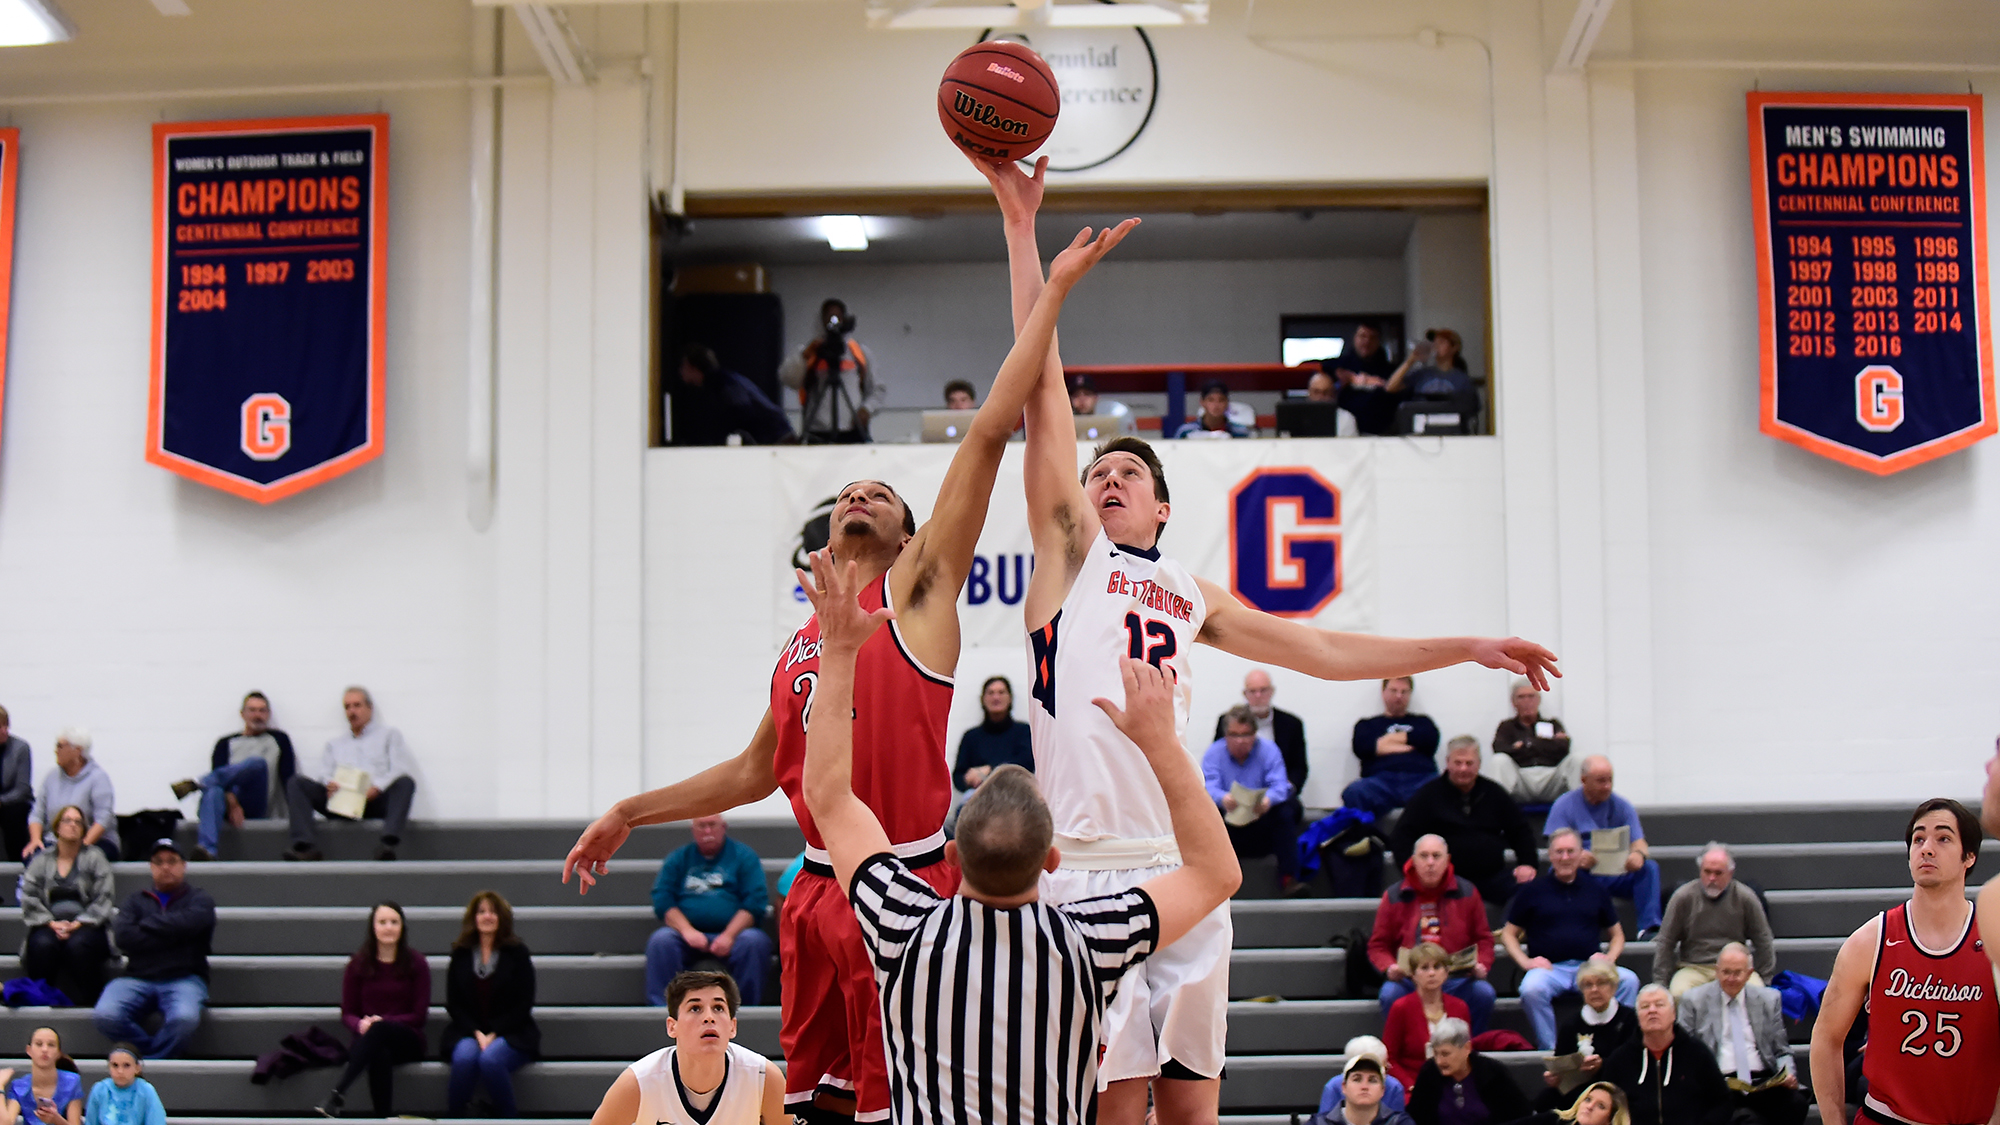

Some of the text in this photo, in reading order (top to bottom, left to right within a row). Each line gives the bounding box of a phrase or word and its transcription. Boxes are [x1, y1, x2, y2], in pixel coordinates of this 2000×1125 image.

[986, 62, 1025, 83] Bullets
[954, 88, 1029, 136] Wilson
[954, 132, 1010, 158] NCAA
[1785, 125, 1946, 148] MEN'S SWIMMING
[175, 150, 364, 172] WOMEN'S OUTDOOR TRACK & FIELD
[1777, 152, 1960, 188] CHAMPIONS
[177, 175, 361, 217] CHAMPIONS
[1778, 194, 1961, 214] CENTENNIAL CONFERENCE
[175, 217, 360, 243] CENTENNIAL CONFERENCE
[1788, 235, 1959, 259] 1994 1995 1996
[181, 258, 355, 287] 1994 1997 2003
[1789, 260, 1960, 284] 1997 1998 1999
[178, 288, 227, 313] 2004
[1788, 285, 1958, 309] 2001 2003 2011
[1788, 310, 1963, 334] 2012 2013 2014
[1789, 335, 1903, 359] 2015 2016
[1855, 365, 1904, 432] G
[241, 392, 291, 460] G
[1229, 466, 1342, 618] G
[967, 554, 1034, 606] BU
[784, 629, 824, 673] Dick
[1124, 610, 1178, 686] 12
[1885, 968, 1984, 1001] Dickinson
[1900, 1009, 1963, 1057] 25
